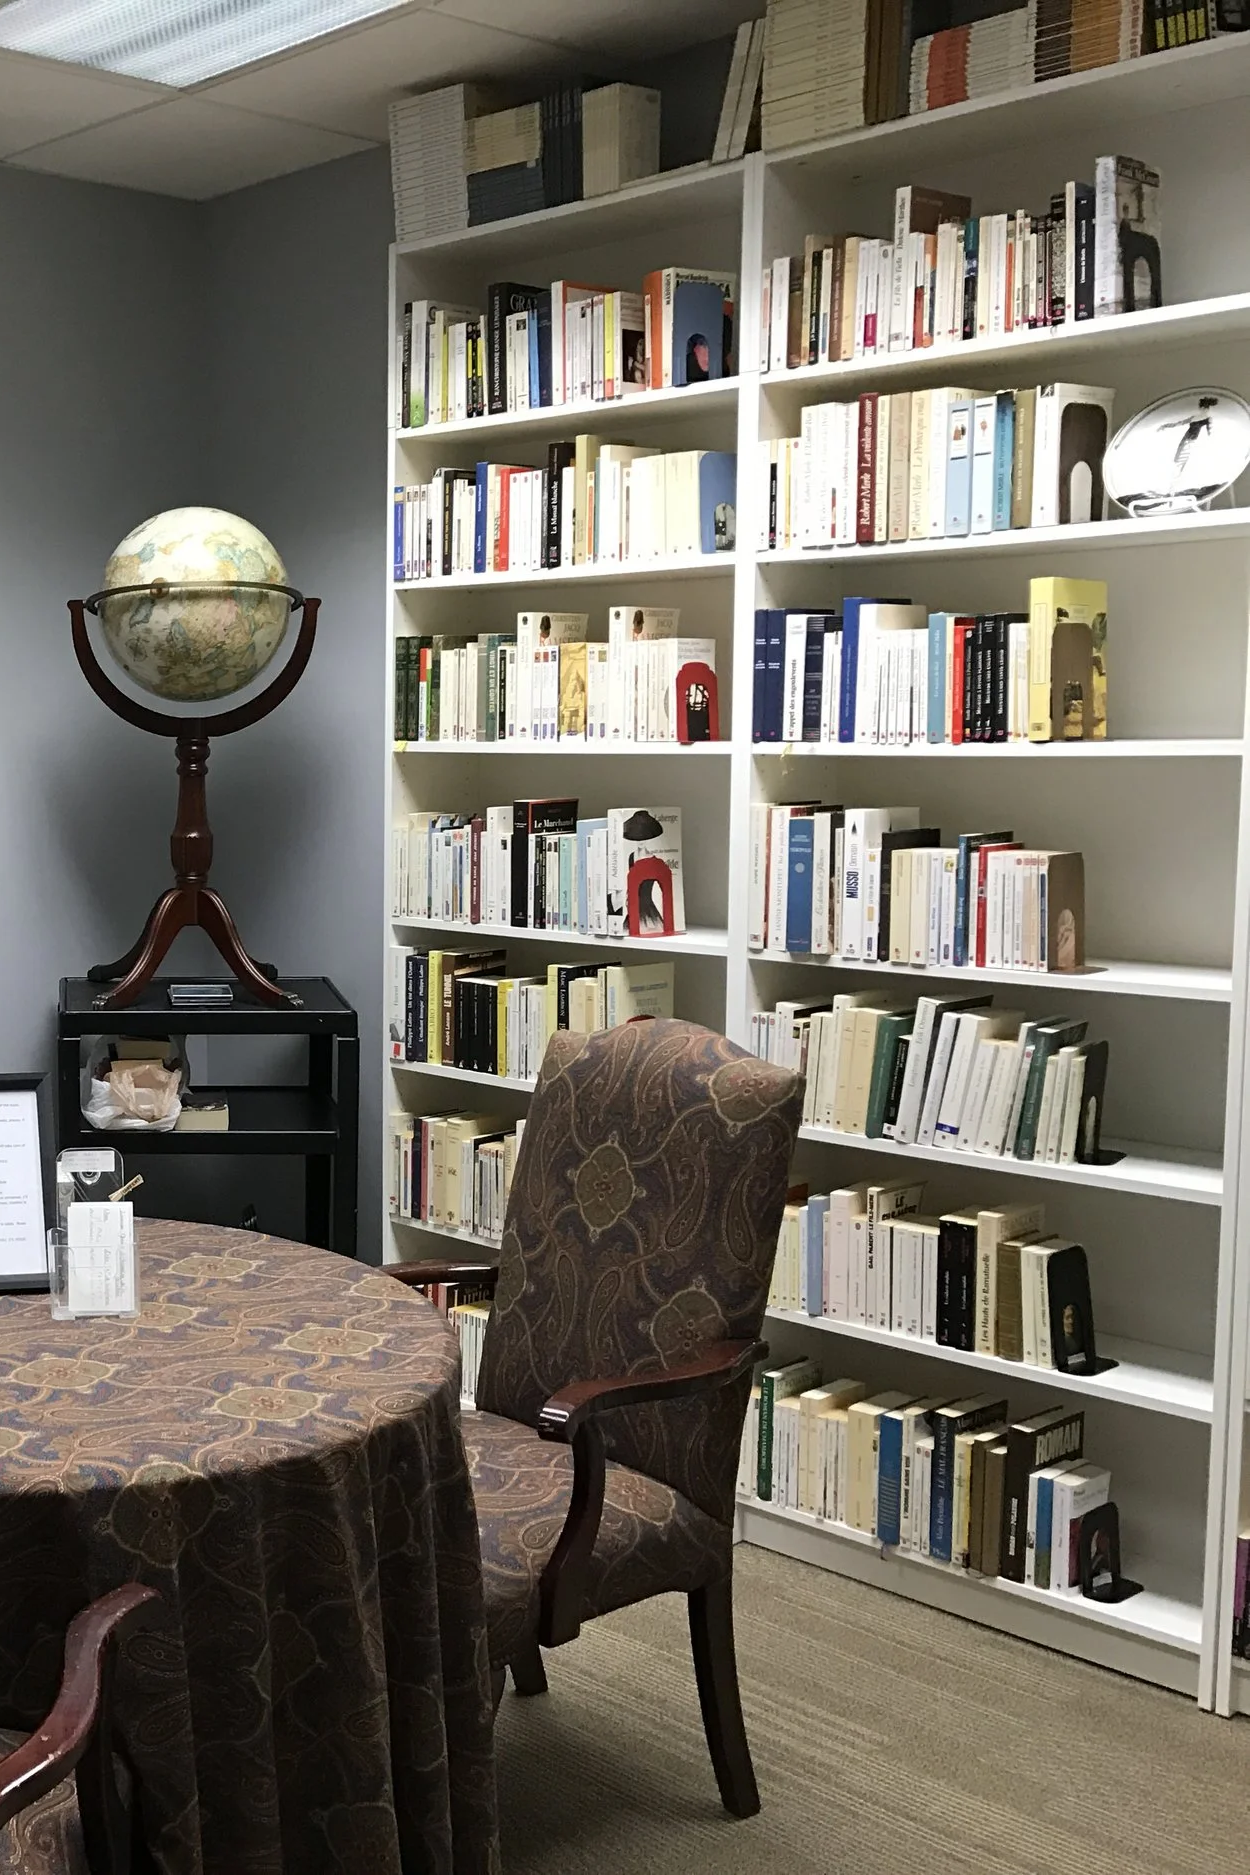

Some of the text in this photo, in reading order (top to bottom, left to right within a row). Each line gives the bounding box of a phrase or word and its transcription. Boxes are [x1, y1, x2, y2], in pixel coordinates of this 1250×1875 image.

[862, 453, 871, 468] La
[860, 473, 871, 498] Merle
[860, 498, 871, 526] Robert
[550, 526, 557, 534] La
[534, 819, 543, 829] Le
[845, 843, 859, 899] MUSSO Demain
[443, 973, 452, 998] TUNNEL
[443, 999, 452, 1008] LE
[428, 1008, 436, 1034] LABRO
[981, 1253, 990, 1343] Les Hauts de Ramatuelle
[1035, 1419, 1082, 1466] ROMAN
[938, 1459, 946, 1476] MAL
[937, 1479, 945, 1490] LE
